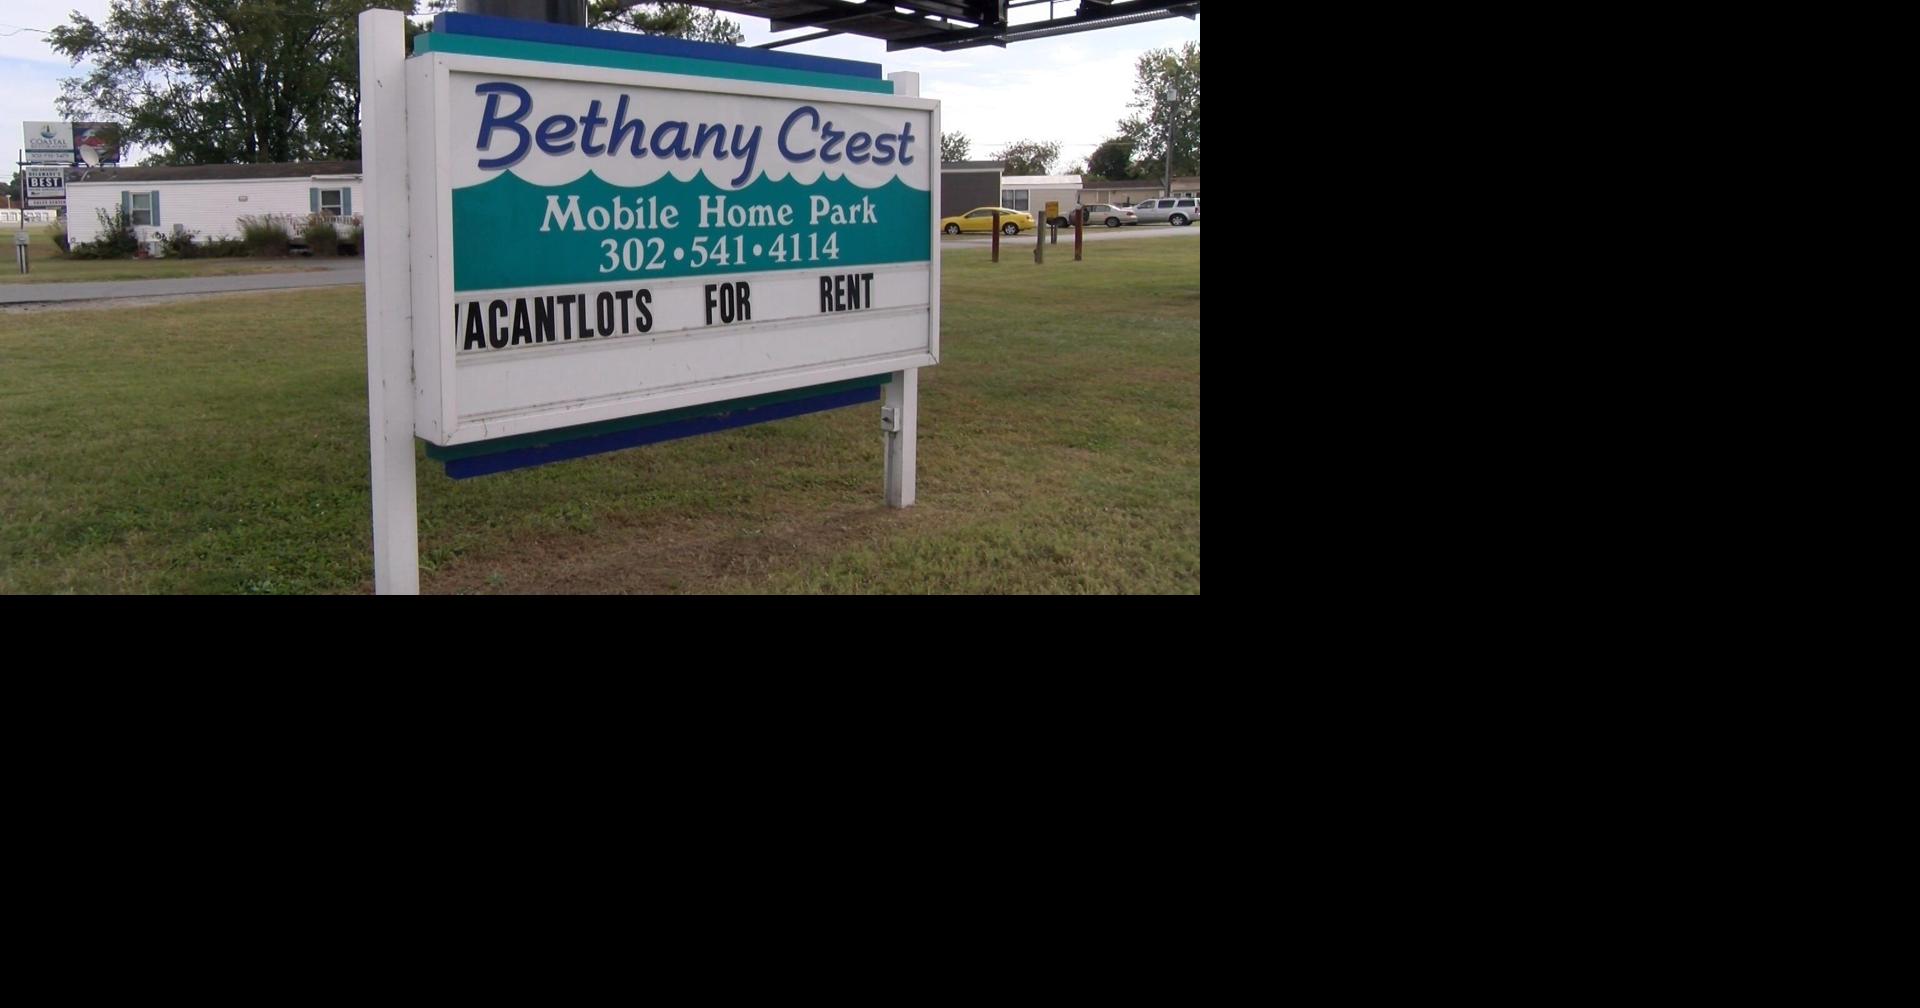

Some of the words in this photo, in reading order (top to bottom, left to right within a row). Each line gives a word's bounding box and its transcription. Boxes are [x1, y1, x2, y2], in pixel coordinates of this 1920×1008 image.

[475, 82, 763, 189] Bethany
[778, 105, 915, 166] Crest
[31, 177, 58, 187] BEST
[540, 195, 679, 232] Mobile
[698, 195, 793, 228] Home
[809, 195, 878, 225] Park
[705, 281, 752, 325] FOR
[820, 272, 874, 313] RENT
